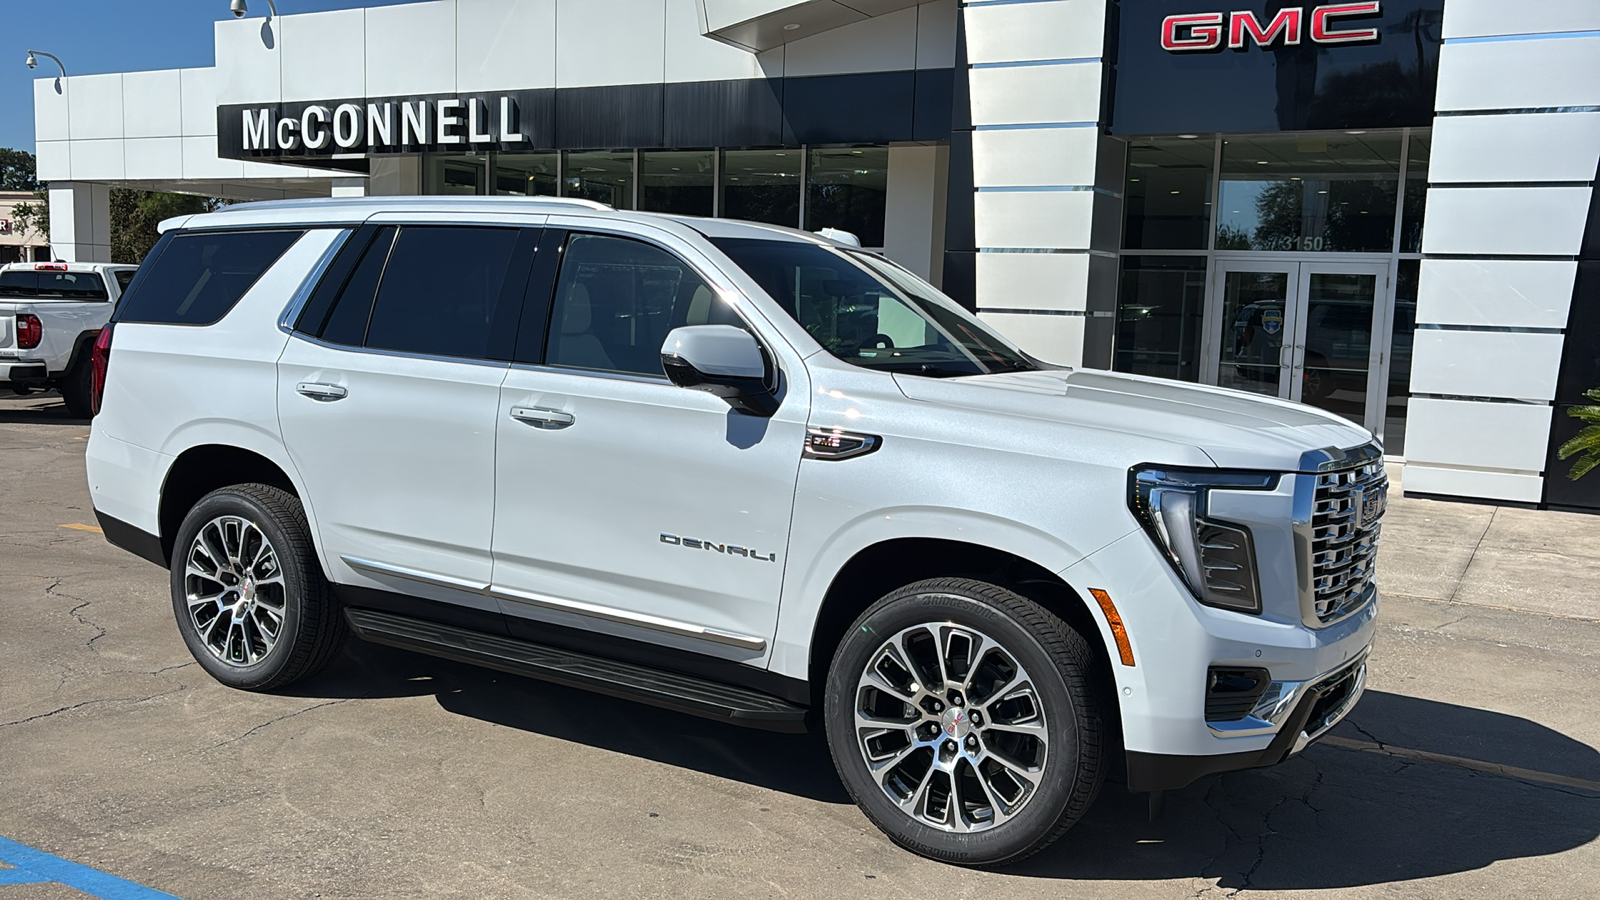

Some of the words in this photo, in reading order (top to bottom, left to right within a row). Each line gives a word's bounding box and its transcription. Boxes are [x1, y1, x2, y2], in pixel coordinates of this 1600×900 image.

[1161, 1, 1380, 50] GMC
[242, 97, 525, 150] McCONNELL
[1283, 236, 1323, 251] 3150
[660, 532, 776, 562] DENALI
[947, 712, 964, 733] GMC
